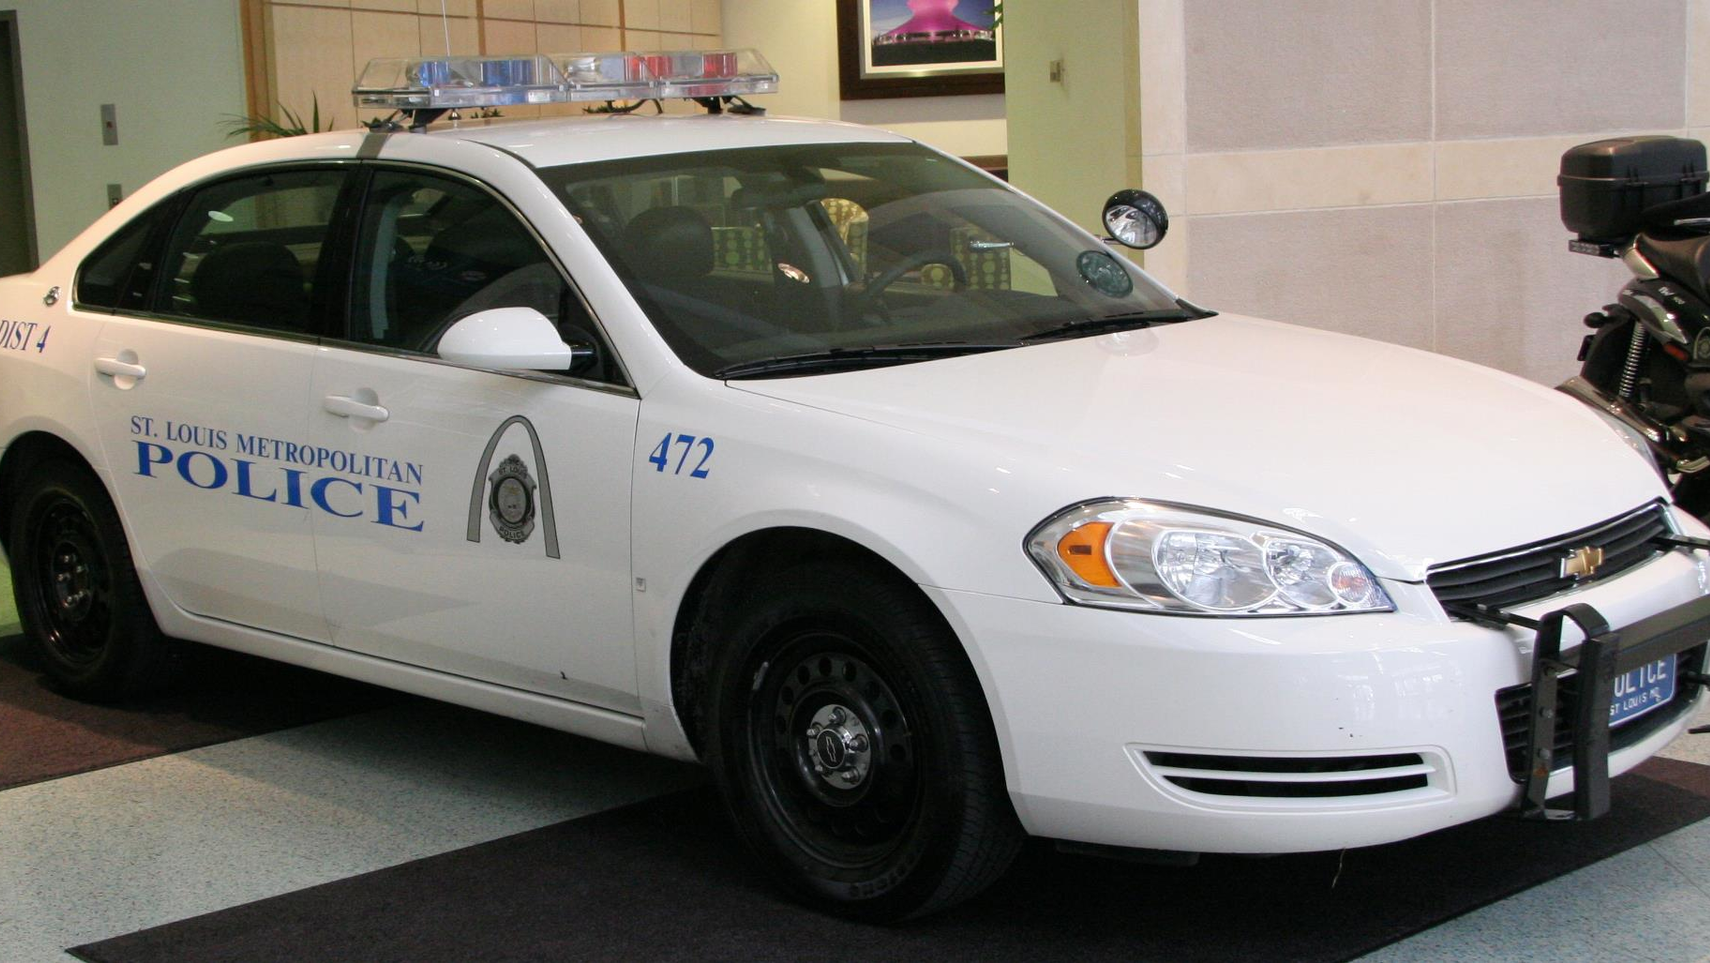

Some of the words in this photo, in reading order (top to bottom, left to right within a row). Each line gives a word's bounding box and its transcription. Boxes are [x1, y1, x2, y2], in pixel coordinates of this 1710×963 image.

[0, 319, 38, 351] DIST
[36, 325, 51, 353] 4
[130, 415, 158, 437] ST.
[166, 421, 228, 450] LOUIS
[236, 433, 424, 486] METROPOLITAN
[648, 431, 715, 480] 472
[131, 439, 425, 532] POLICE
[1614, 659, 1667, 698] OLICE
[1609, 703, 1620, 716] ST
[1623, 692, 1648, 711] LOUIS
